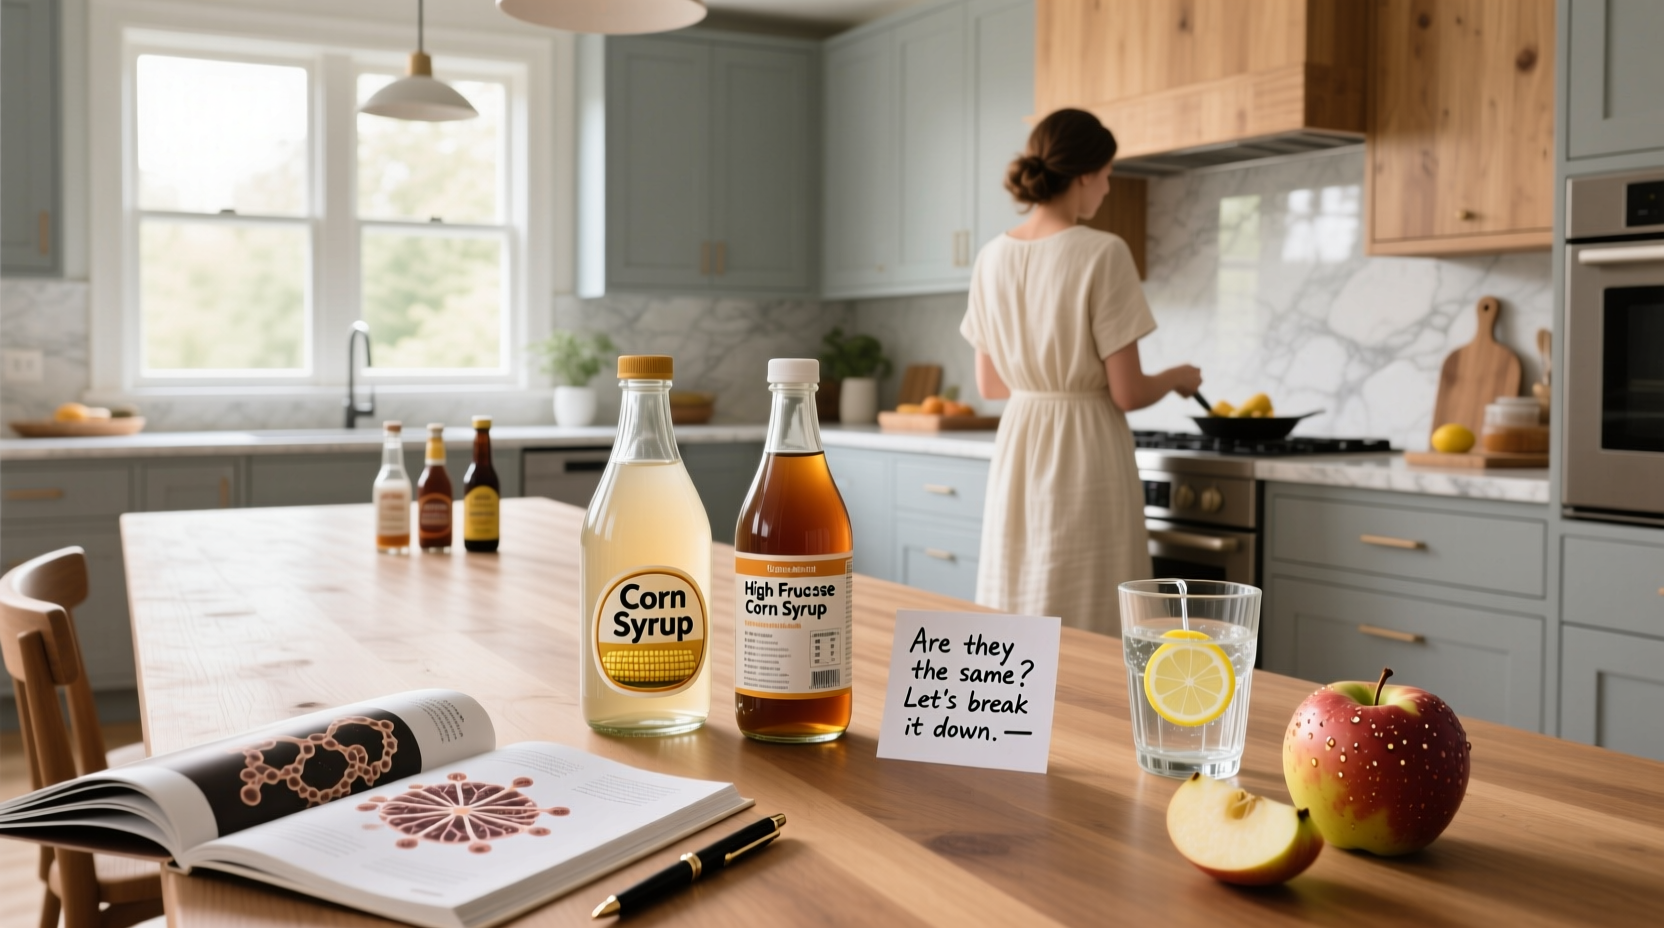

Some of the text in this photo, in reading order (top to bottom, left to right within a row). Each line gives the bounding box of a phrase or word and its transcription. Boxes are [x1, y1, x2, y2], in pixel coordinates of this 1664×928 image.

[619, 583, 687, 610] Corn
[744, 580, 774, 601] High
[745, 599, 828, 621] Corn Syrup
[613, 610, 694, 644] Syrup
[909, 626, 1015, 666] Are they
[911, 658, 1035, 688] the same?
[903, 686, 1029, 715] Let's break
[904, 716, 924, 736] it
[933, 715, 997, 742] down.
